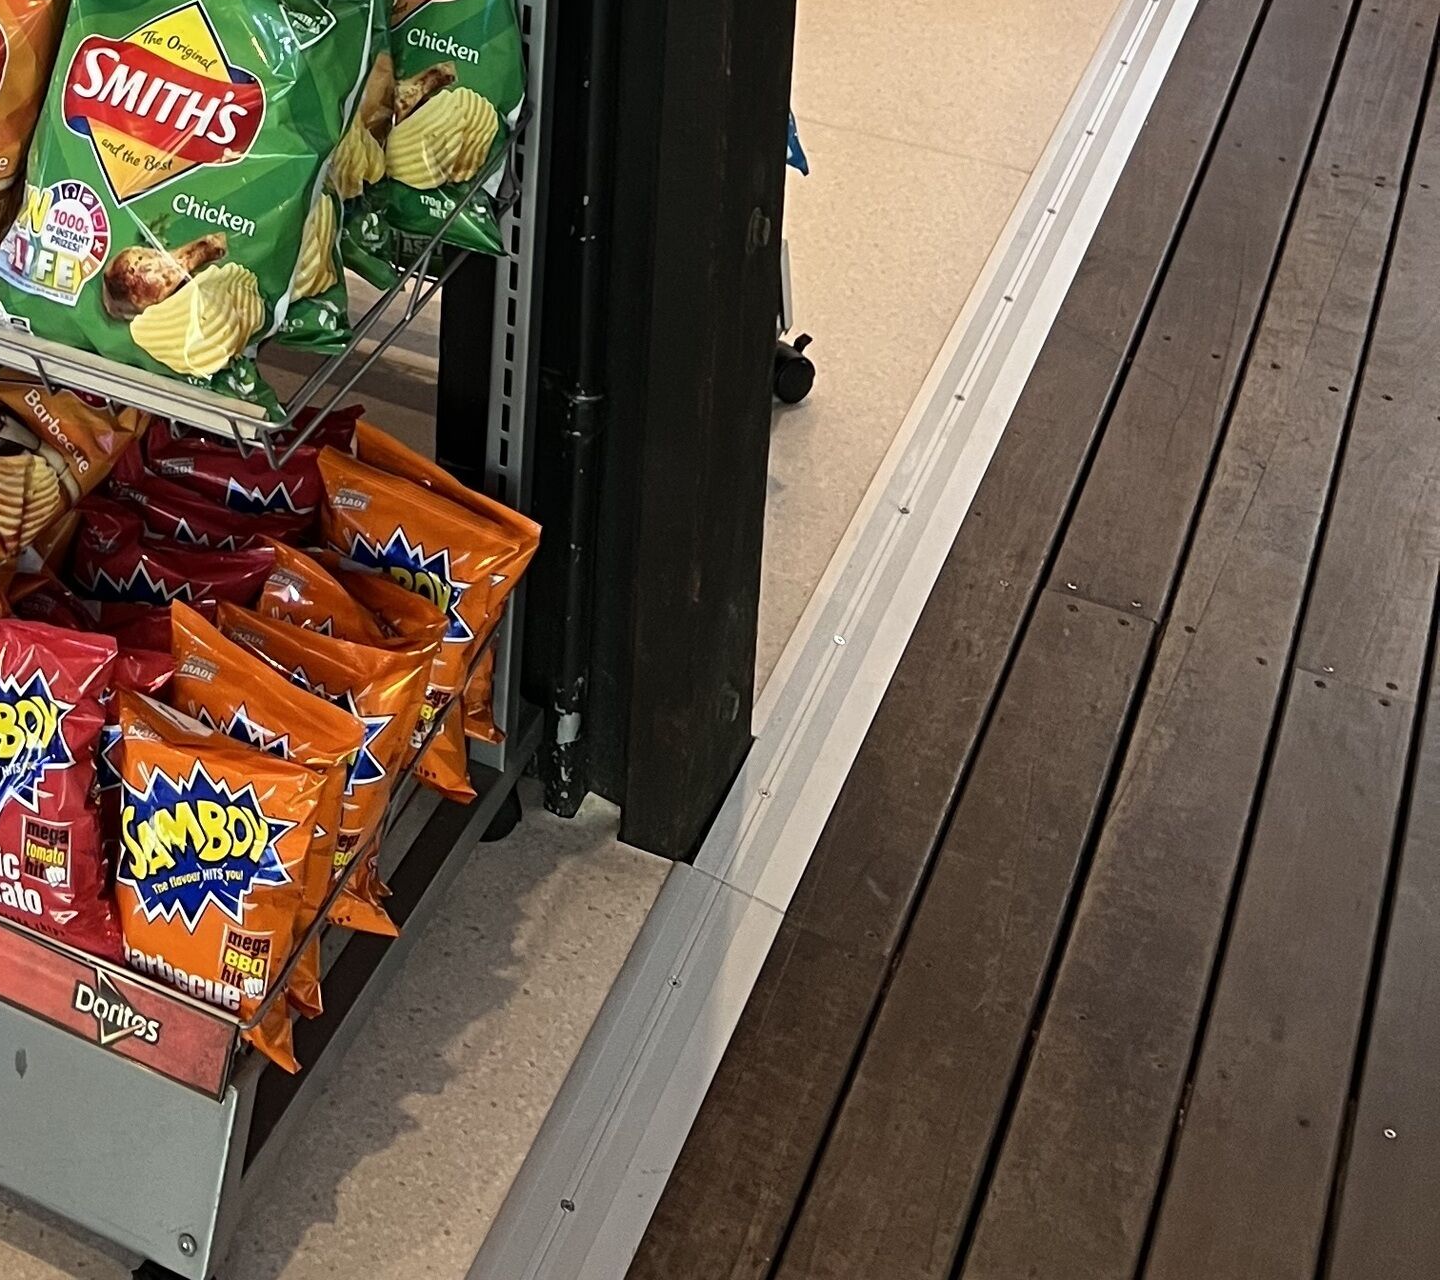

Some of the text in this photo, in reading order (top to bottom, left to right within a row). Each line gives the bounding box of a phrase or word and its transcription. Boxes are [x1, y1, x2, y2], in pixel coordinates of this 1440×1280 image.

[140, 29, 217, 72] The Original
[406, 27, 480, 64] Chicken
[72, 47, 248, 146] SMITH'S
[143, 154, 174, 173] Best
[171, 193, 256, 237] Chicken
[57, 225, 91, 248] INSTANT
[23, 389, 92, 475] Barbecue
[181, 662, 215, 682] MADE
[26, 821, 68, 842] mega
[122, 797, 270, 880] SAMBOY
[25, 838, 67, 866] tomato
[226, 931, 271, 956] mega
[224, 949, 266, 977] BBQ
[74, 981, 160, 1044] Doritos
